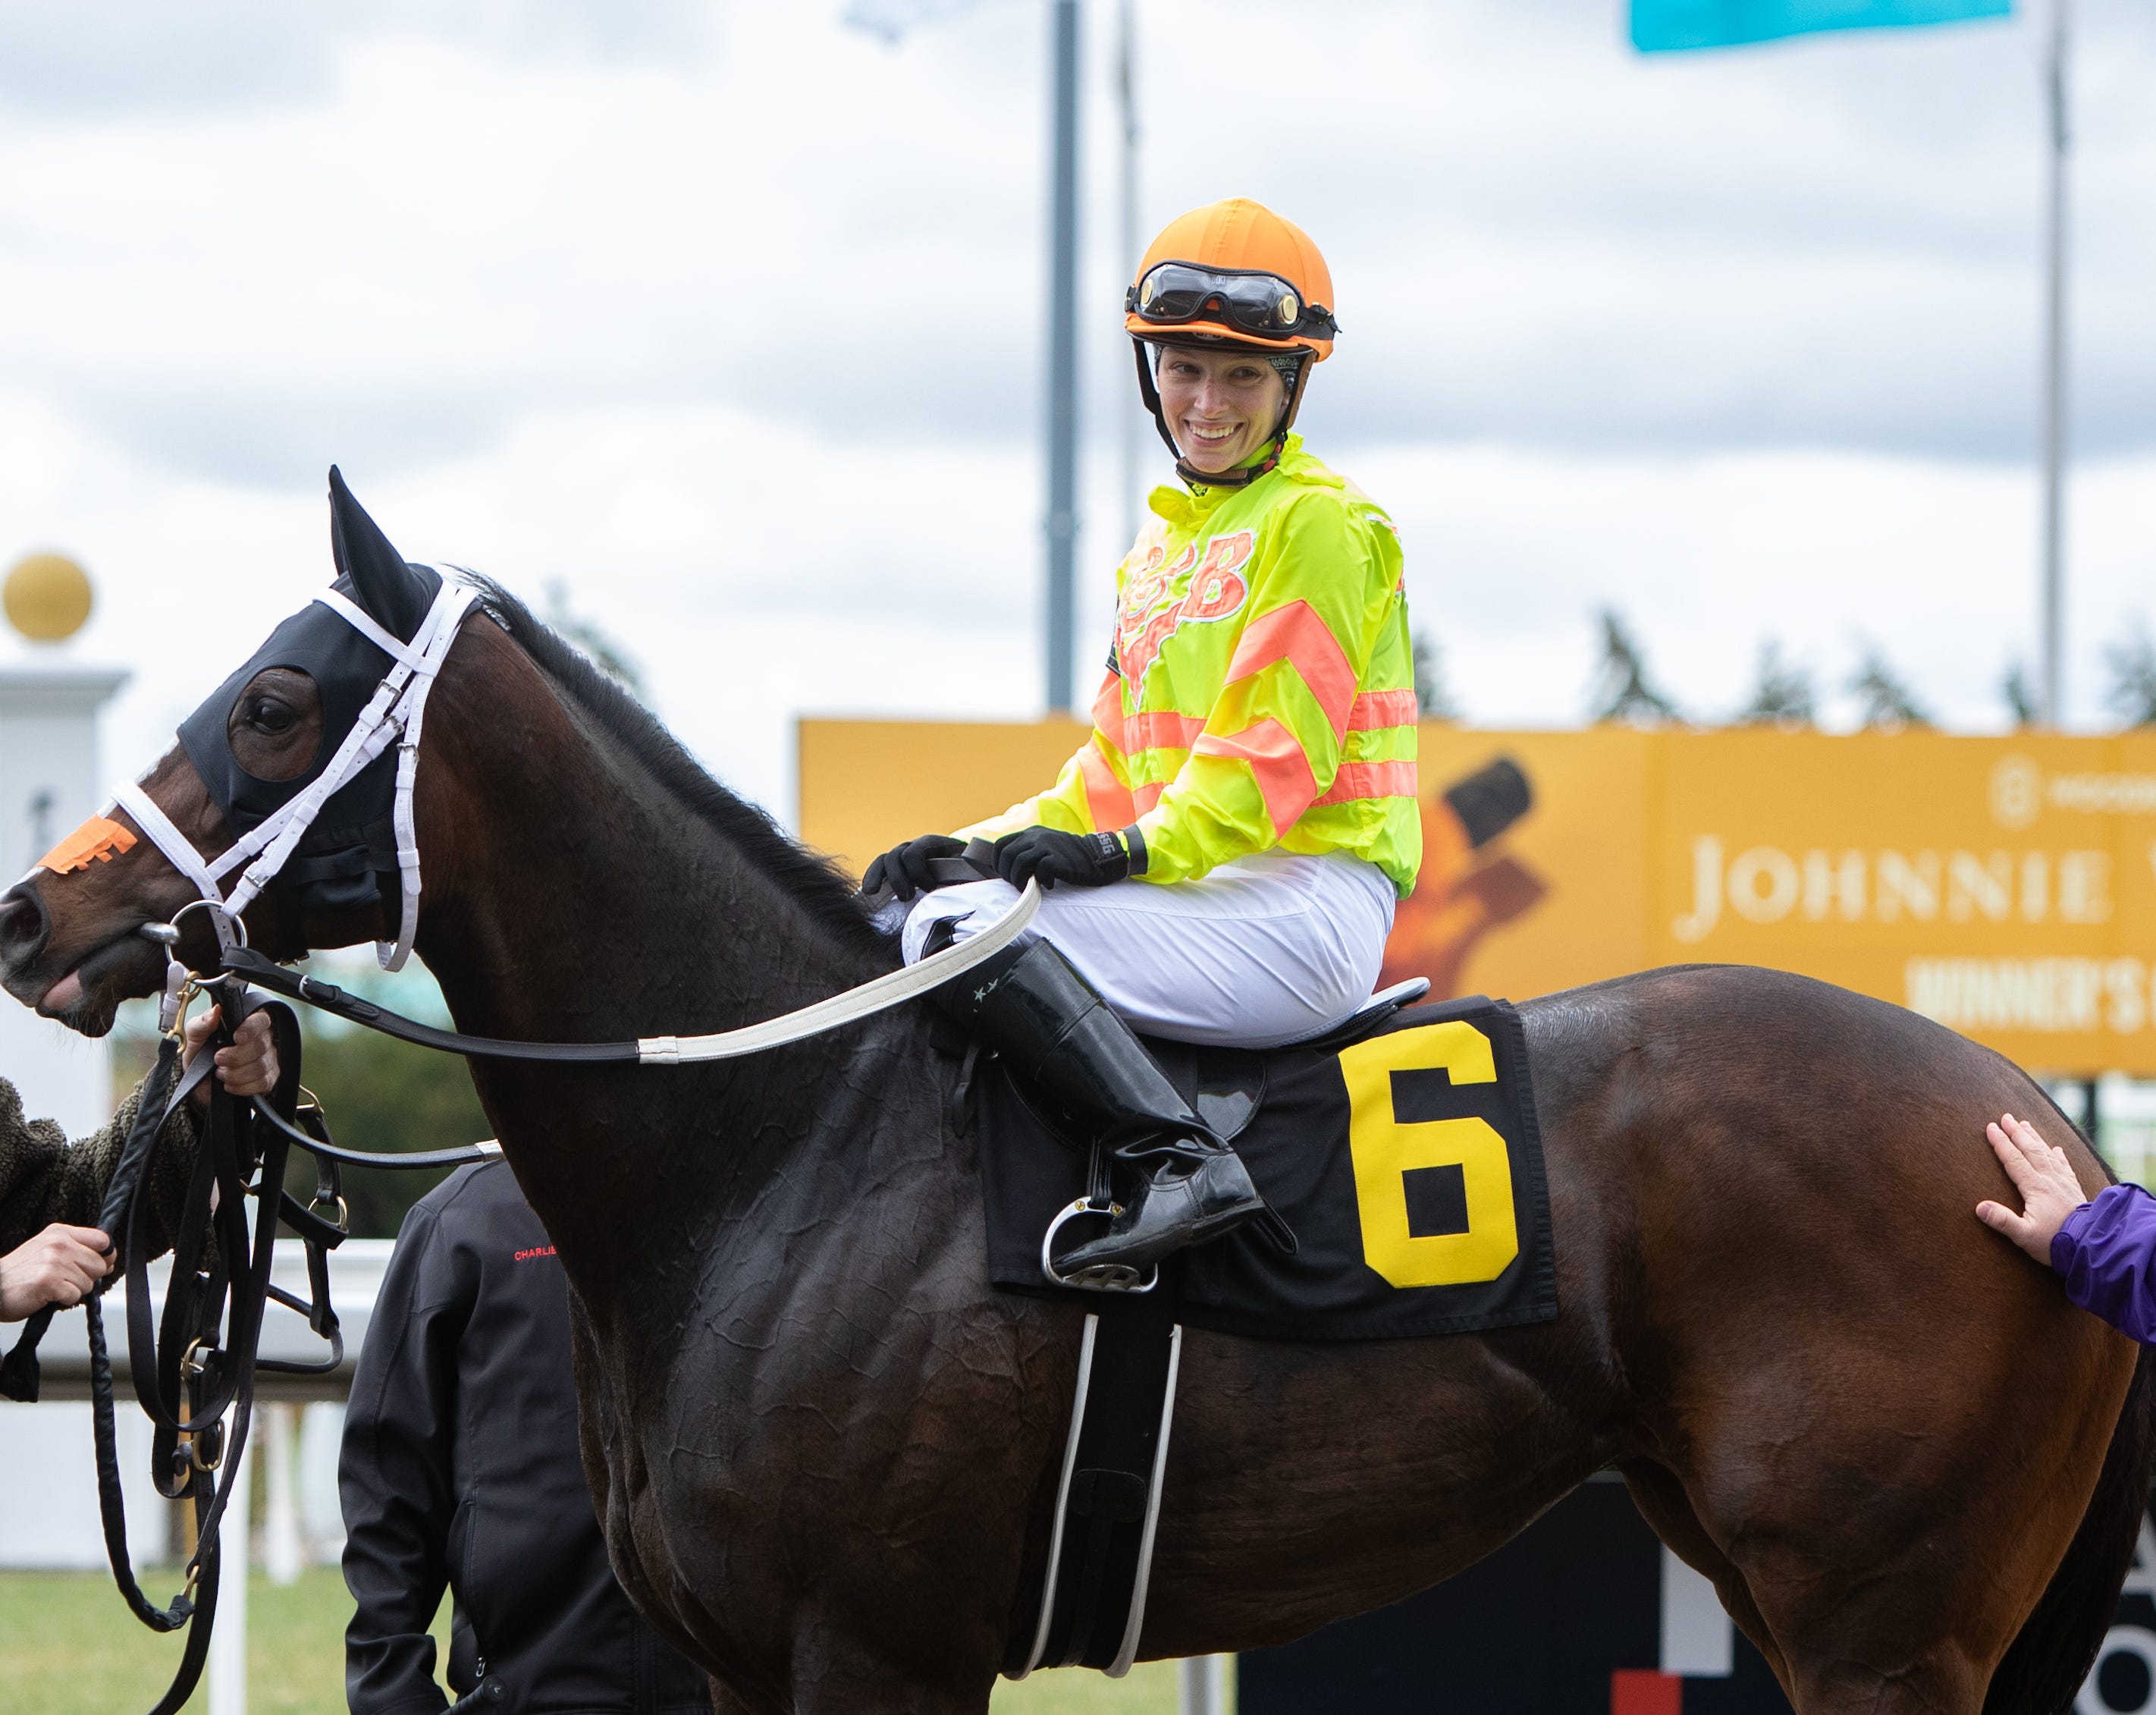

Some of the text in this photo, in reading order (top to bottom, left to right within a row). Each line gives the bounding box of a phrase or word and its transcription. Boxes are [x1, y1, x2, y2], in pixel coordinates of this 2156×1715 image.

[1672, 835, 2113, 944] JOHNNIE
[1904, 956, 2145, 1035] WINNER'S
[1338, 1020, 1519, 1289] 6
